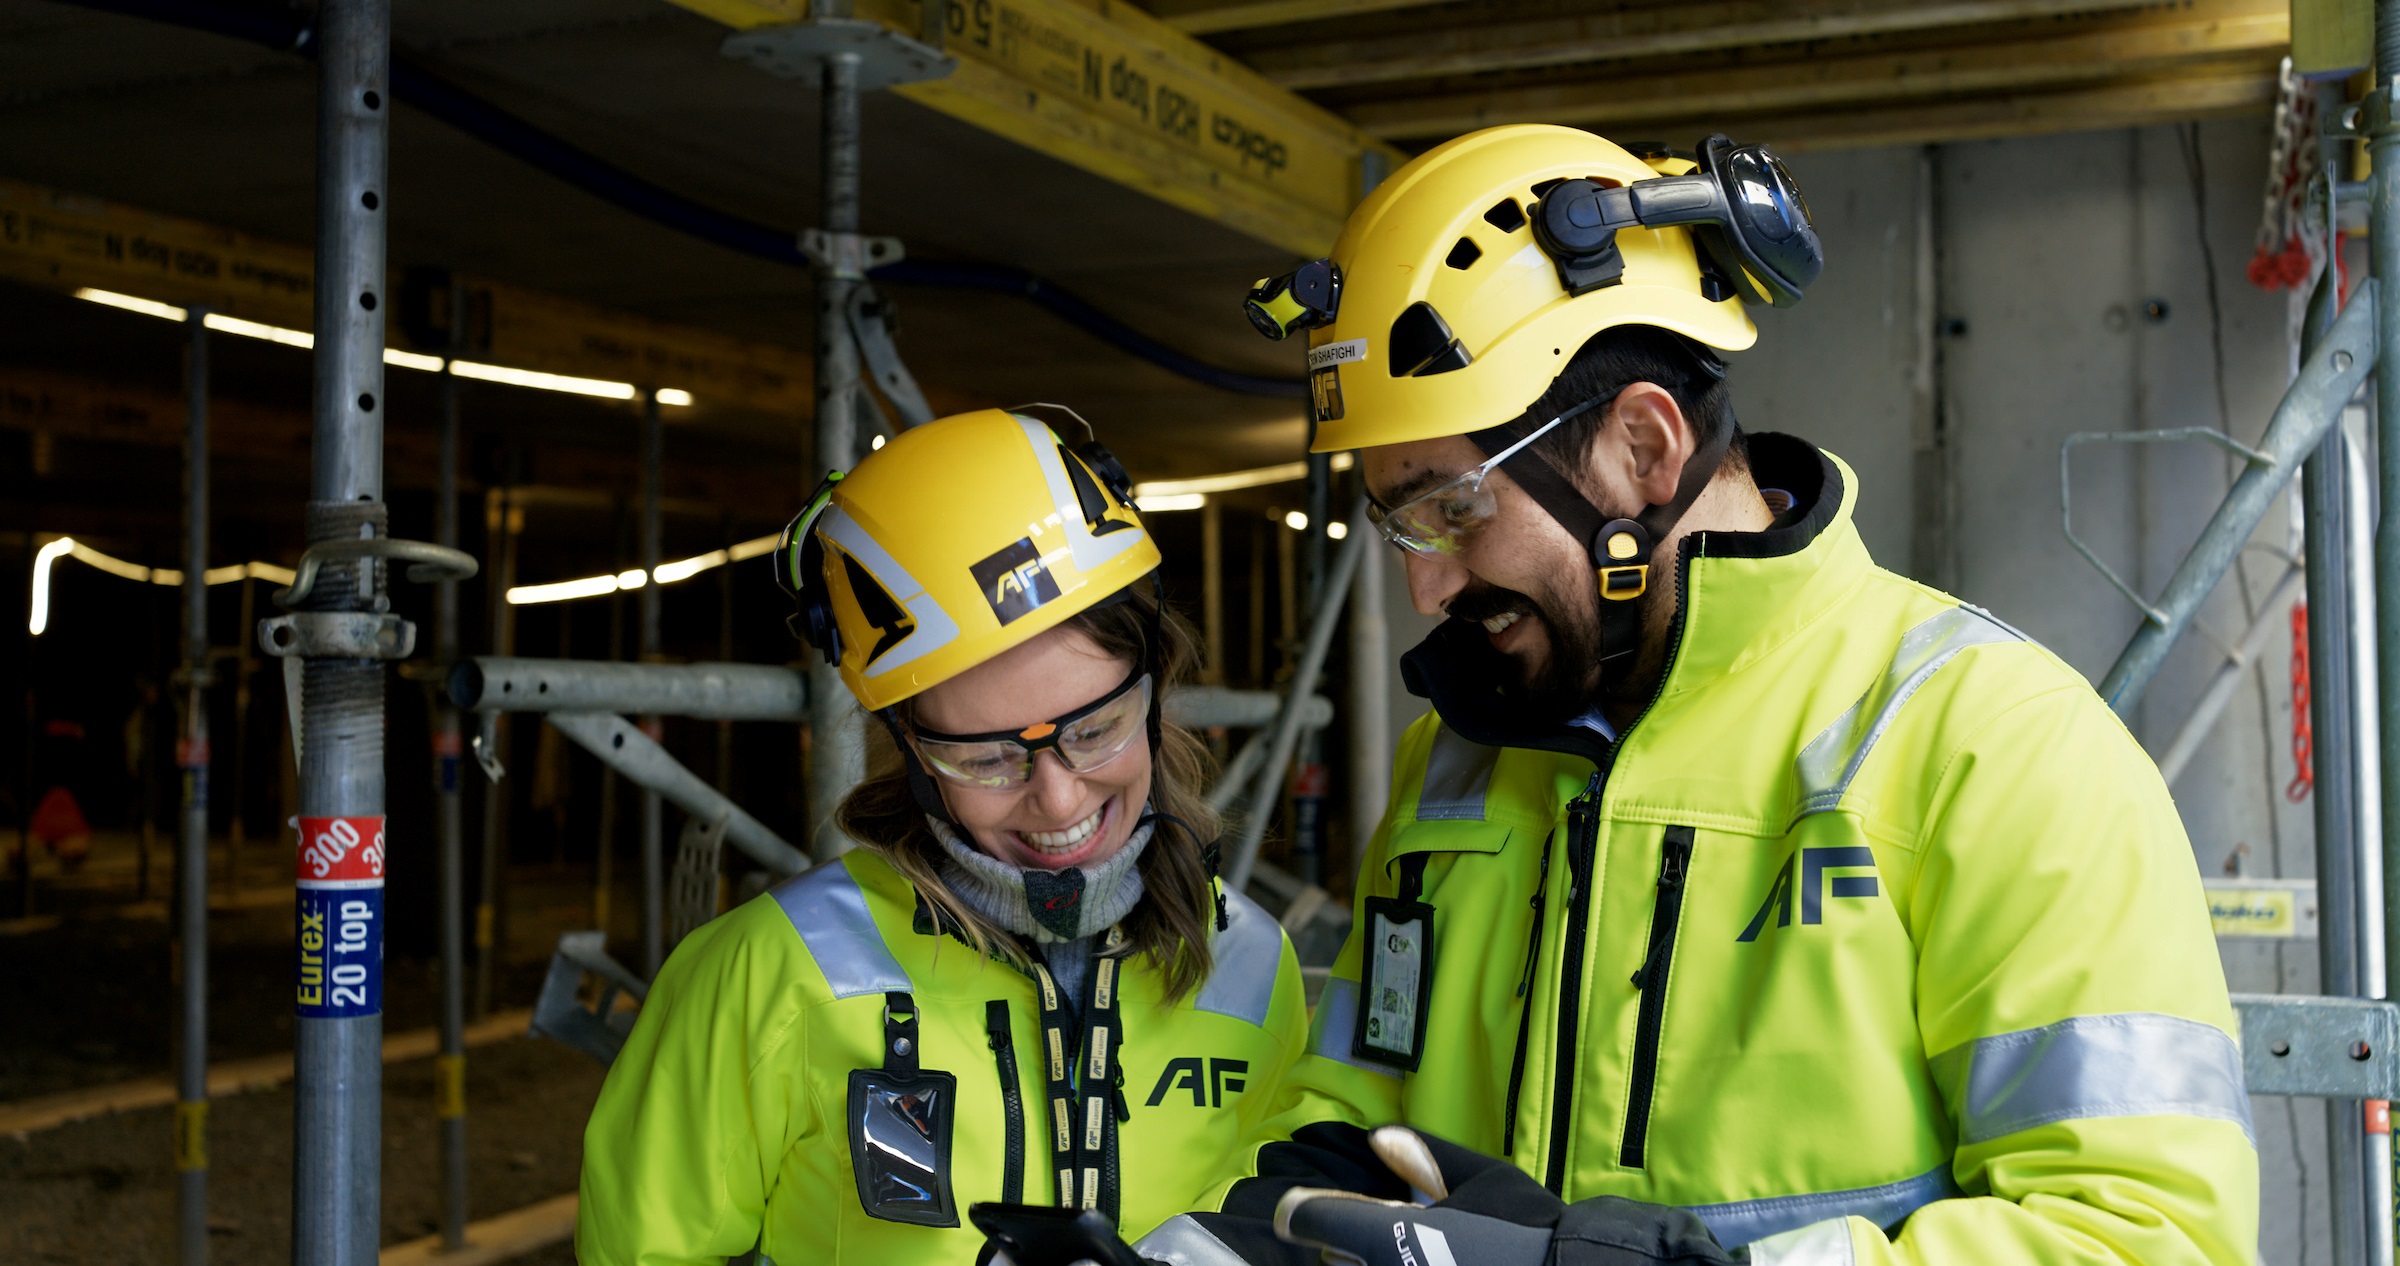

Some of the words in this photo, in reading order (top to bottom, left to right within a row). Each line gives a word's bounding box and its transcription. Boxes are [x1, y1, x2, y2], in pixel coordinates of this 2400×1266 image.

[1084, 48, 1102, 101] N
[1318, 345, 1356, 363] SHAFIGHI
[997, 558, 1041, 604] AF
[305, 818, 360, 878] 300
[1735, 847, 1879, 942] AF
[334, 900, 373, 954] top
[297, 912, 324, 1006] Eurex
[331, 964, 367, 1007] 20
[1144, 1057, 1249, 1109] AF
